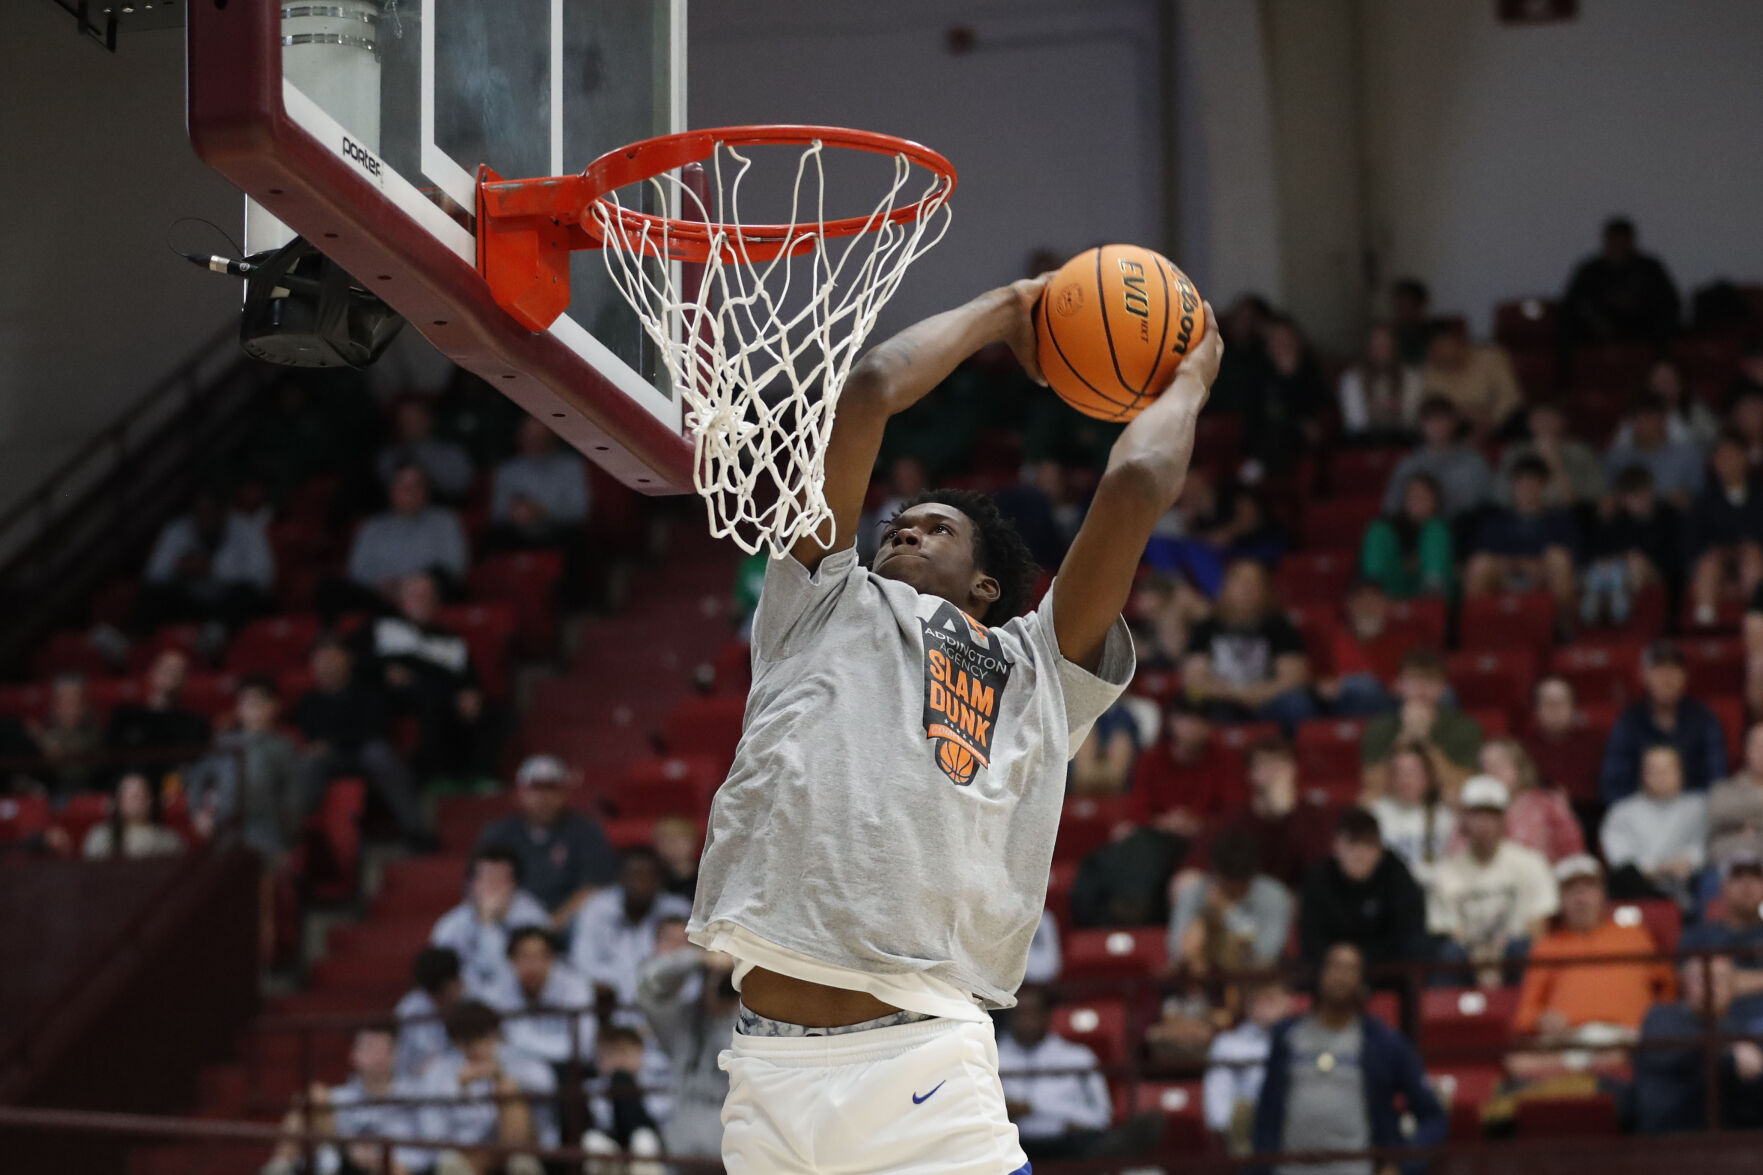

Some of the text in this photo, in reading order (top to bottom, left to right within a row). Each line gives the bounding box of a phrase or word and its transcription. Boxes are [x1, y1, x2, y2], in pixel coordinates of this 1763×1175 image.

[1118, 258, 1148, 318] EVO
[924, 627, 1007, 674] ADDINGTON
[940, 642, 988, 680] AGENCY
[928, 649, 995, 717] SLAM
[930, 679, 991, 748] DUNK
